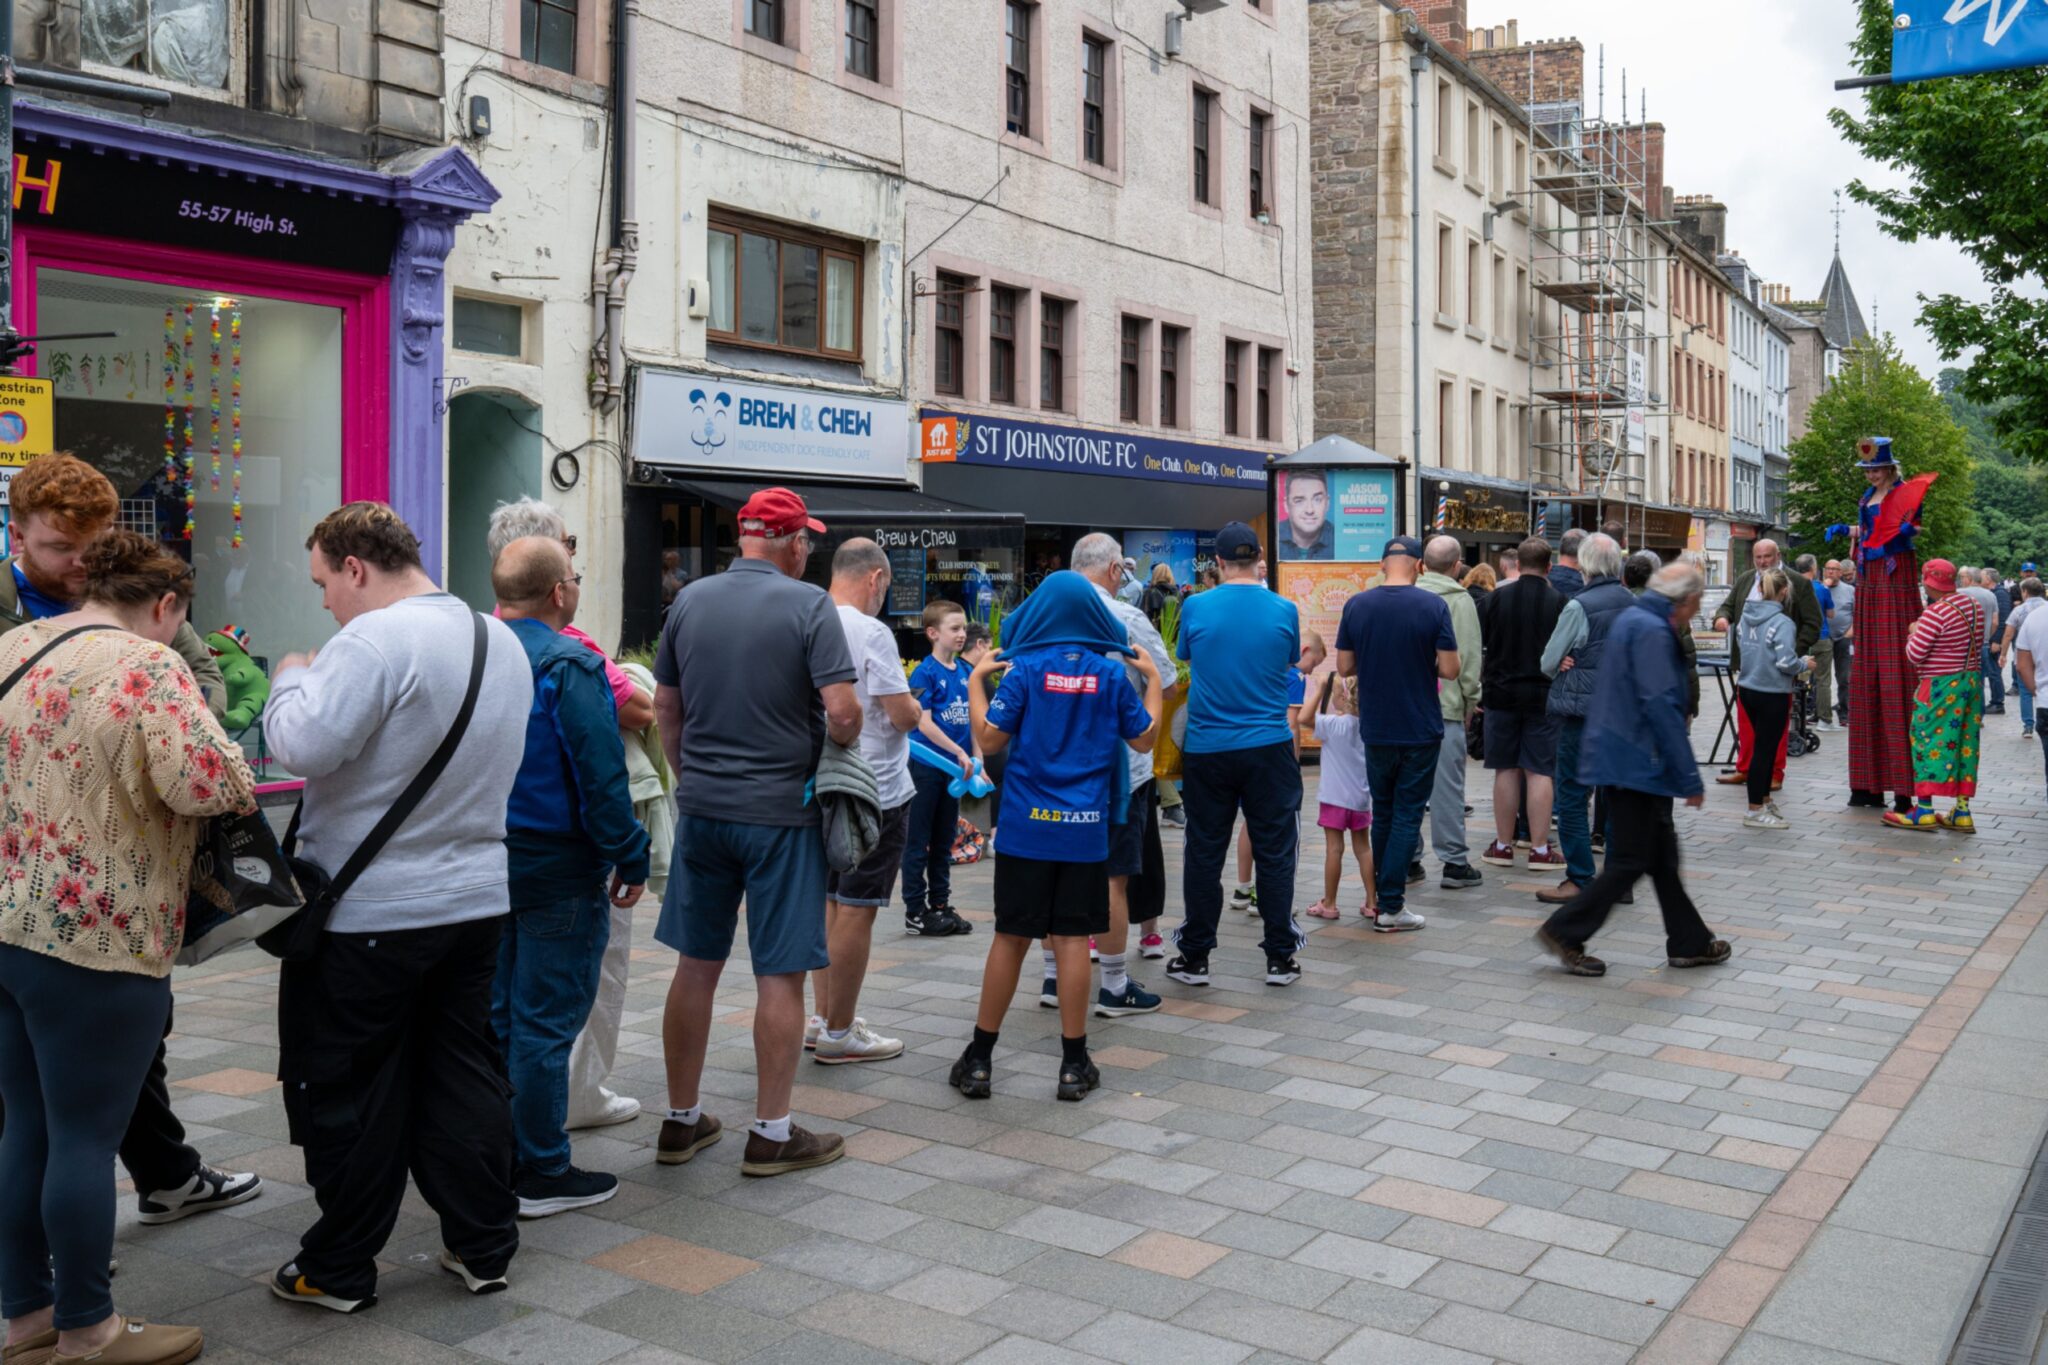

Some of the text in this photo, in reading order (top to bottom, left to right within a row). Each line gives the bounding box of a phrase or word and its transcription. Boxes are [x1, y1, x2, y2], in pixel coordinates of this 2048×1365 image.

[12, 153, 62, 215] H
[178, 200, 298, 236] 55-57 High St.
[0, 383, 44, 394] estrian
[738, 397, 871, 437] BREW & CHEW
[737, 439, 795, 455] INDEPENDENT
[817, 446, 853, 458] FRIENDLY
[926, 448, 952, 457] JUST EAT
[976, 424, 1137, 469] ST JOHNSTONE FC
[0, 450, 41, 462] ny tim
[1144, 454, 1268, 481] One Club. One City. One Commun
[1347, 483, 1381, 494] JASON
[1340, 494, 1388, 505] MANFORD
[875, 528, 907, 548] Brew
[921, 529, 956, 548] Chew
[938, 560, 953, 569] CLUB
[926, 572, 938, 581] IFTS
